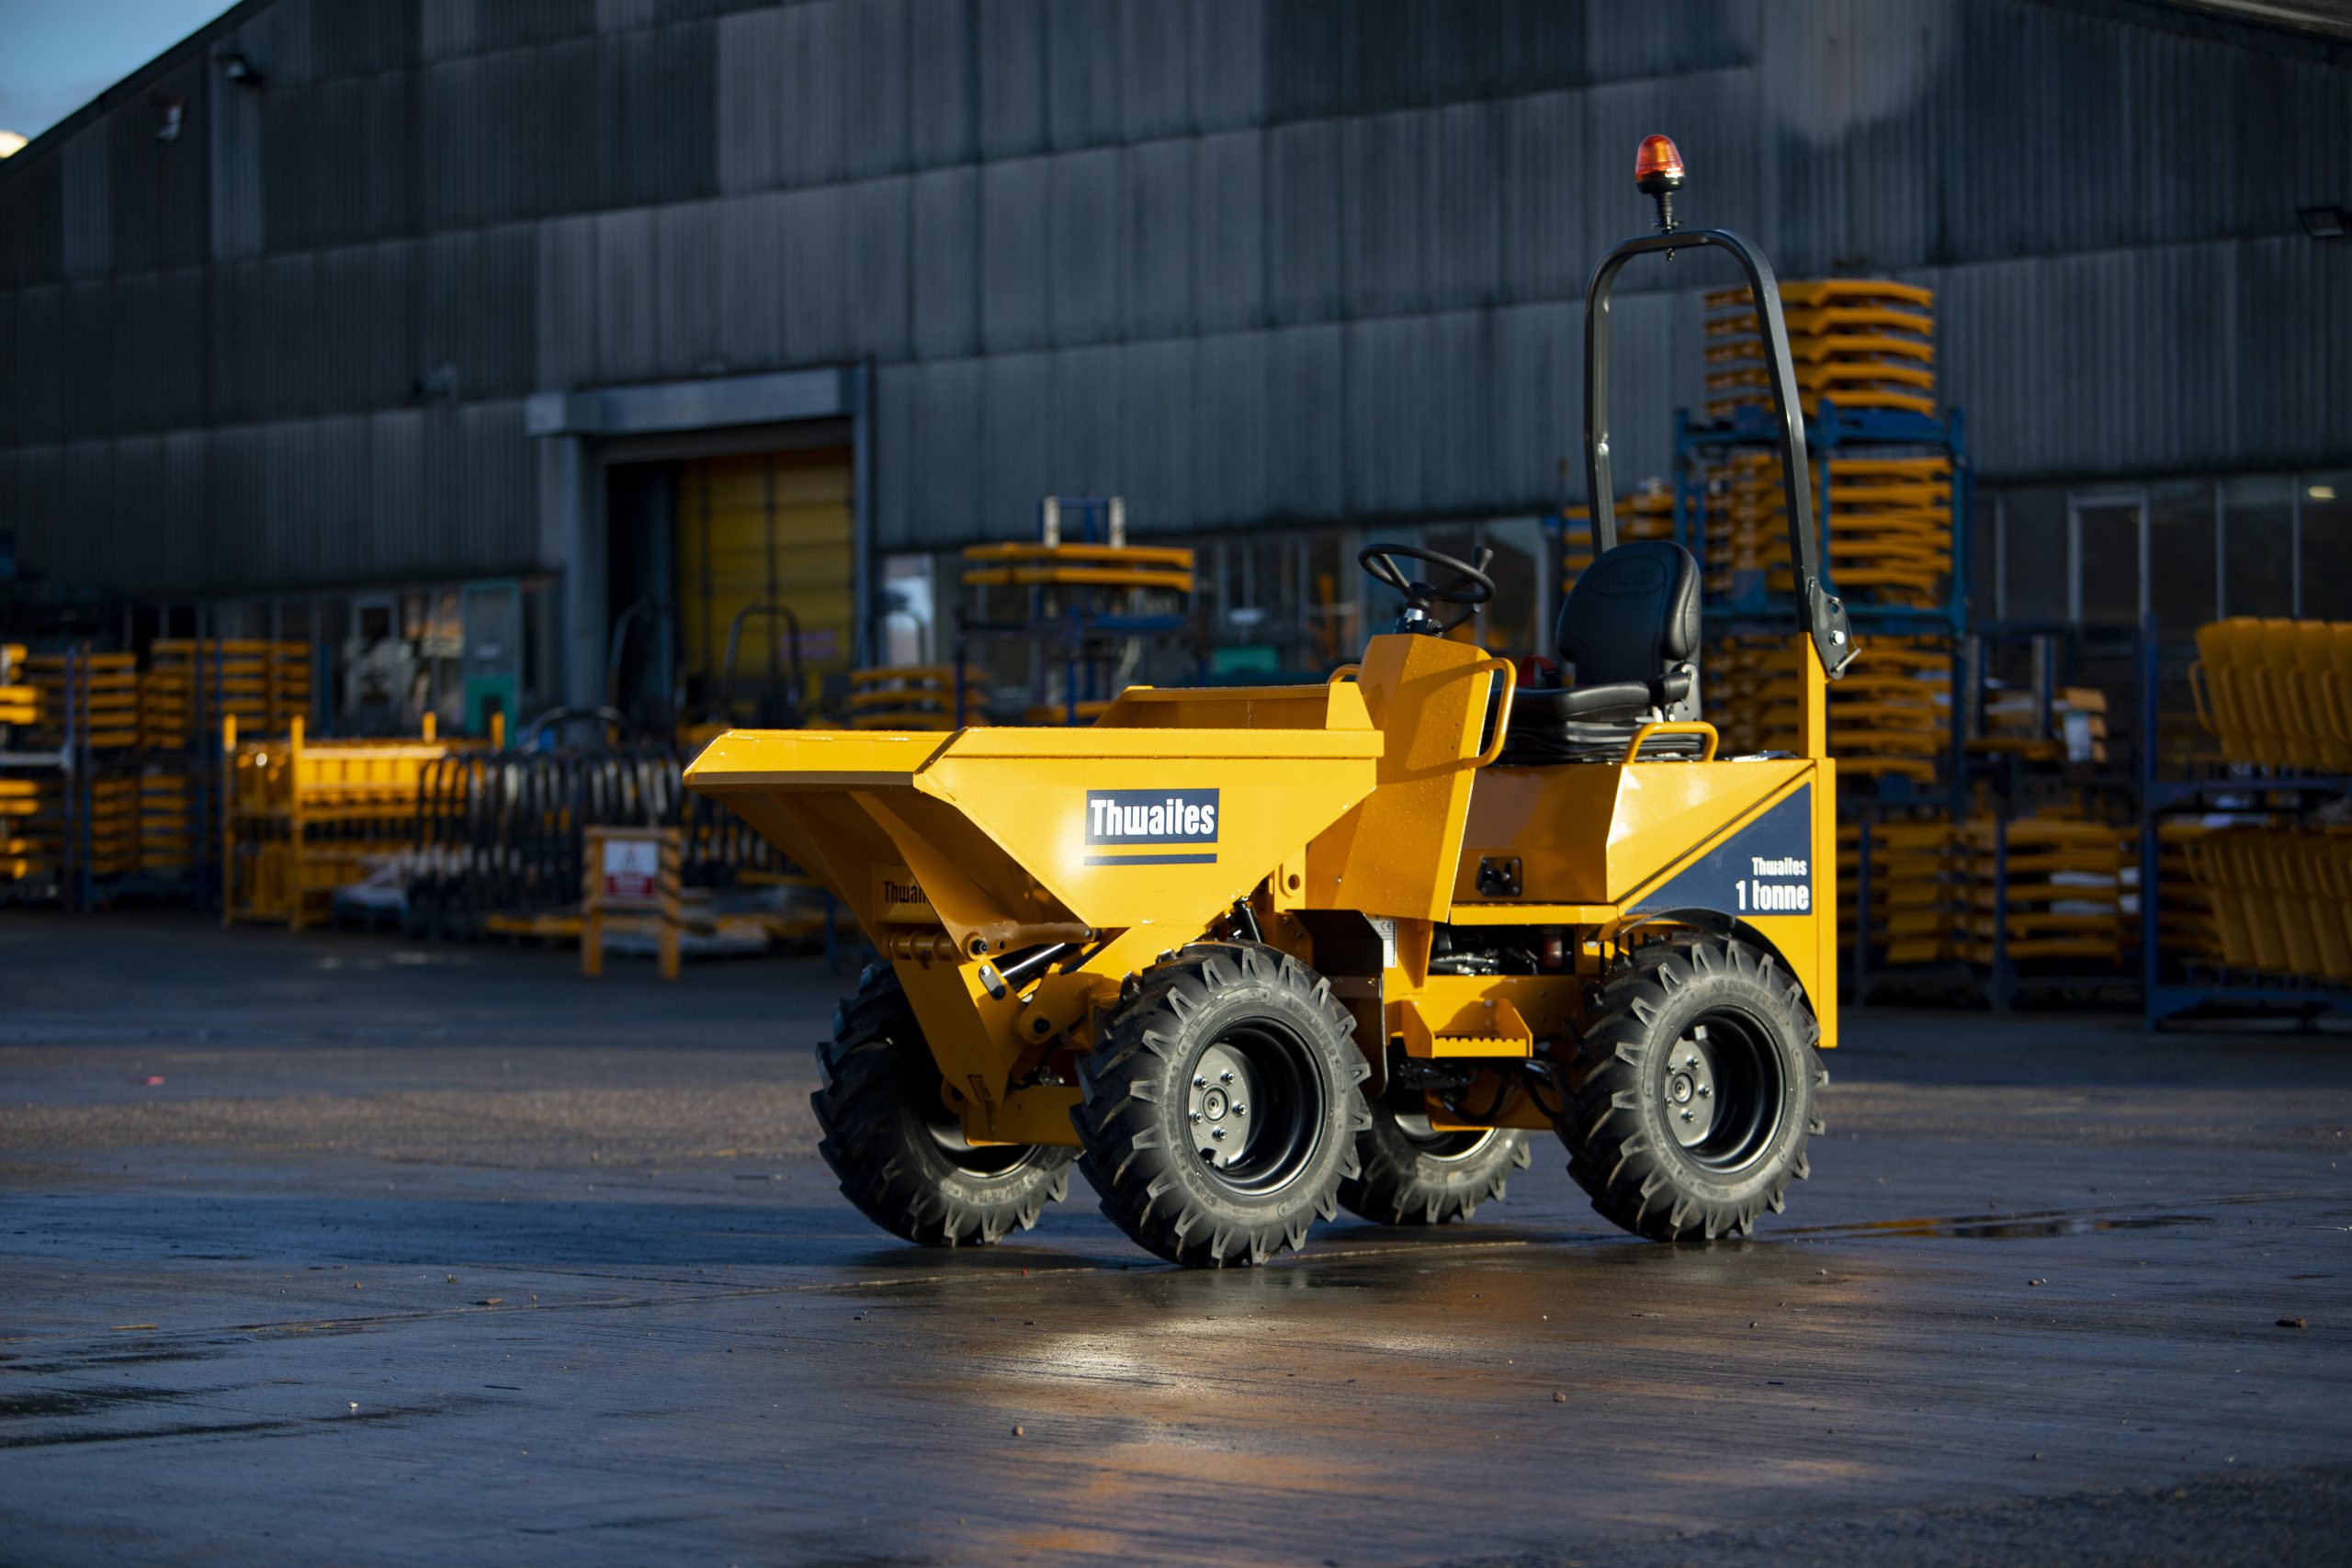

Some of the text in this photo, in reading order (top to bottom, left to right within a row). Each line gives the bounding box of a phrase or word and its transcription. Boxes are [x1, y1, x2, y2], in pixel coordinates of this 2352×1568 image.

[1091, 798, 1215, 836] Thwaites
[1751, 857, 1807, 876] Thwaites
[884, 881, 926, 904] Thwai
[1736, 879, 1810, 911] 1 tonne
[1380, 921, 1392, 931] CE
